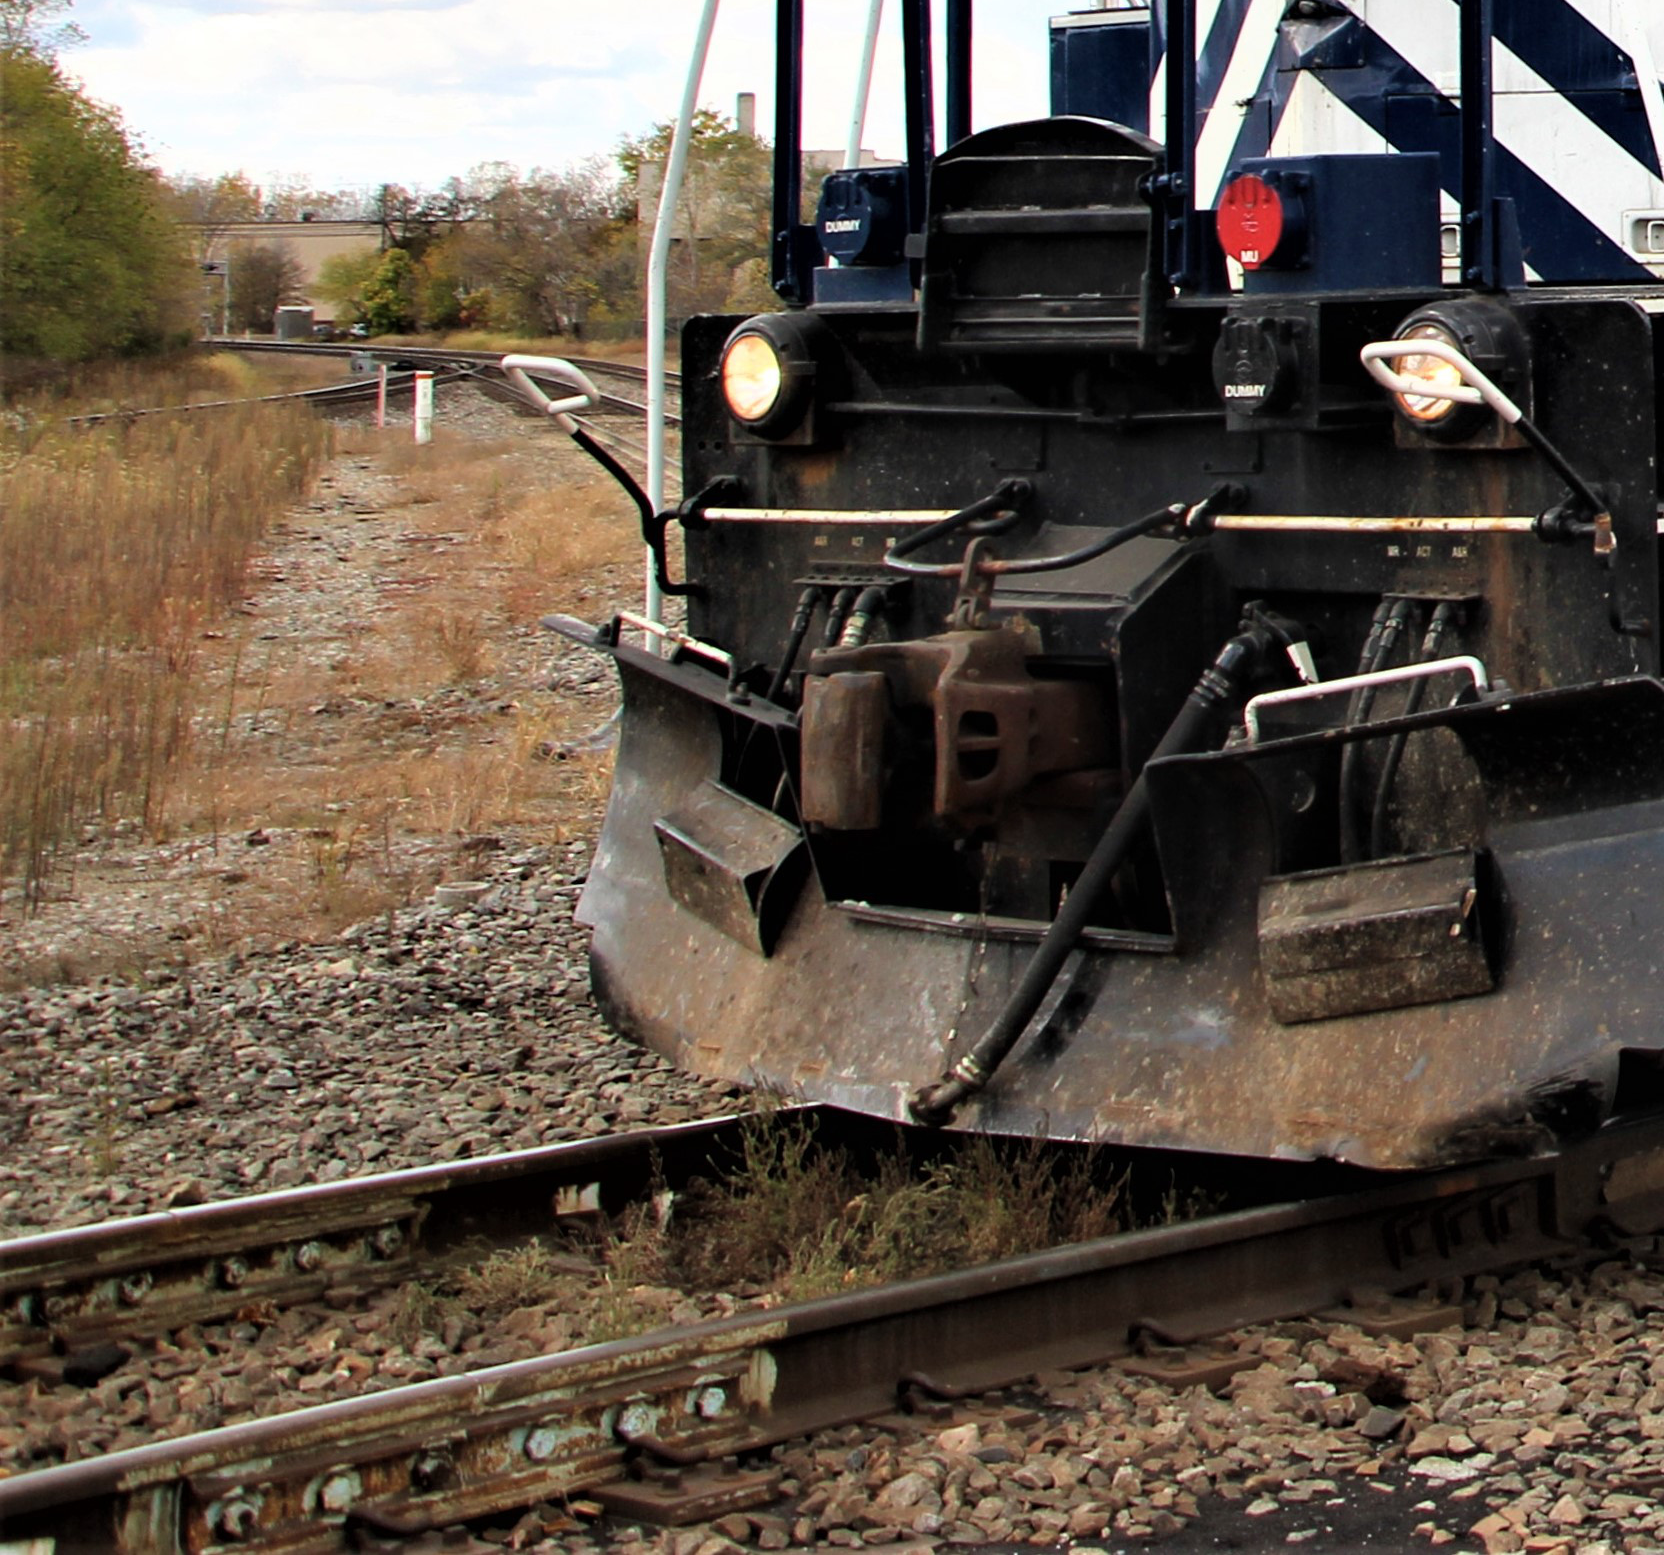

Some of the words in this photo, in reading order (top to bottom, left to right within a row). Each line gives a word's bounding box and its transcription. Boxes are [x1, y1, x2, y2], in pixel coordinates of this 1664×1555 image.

[825, 219, 861, 233] DUMMY
[1241, 250, 1259, 263] MU
[1225, 385, 1265, 398] DUMMY
